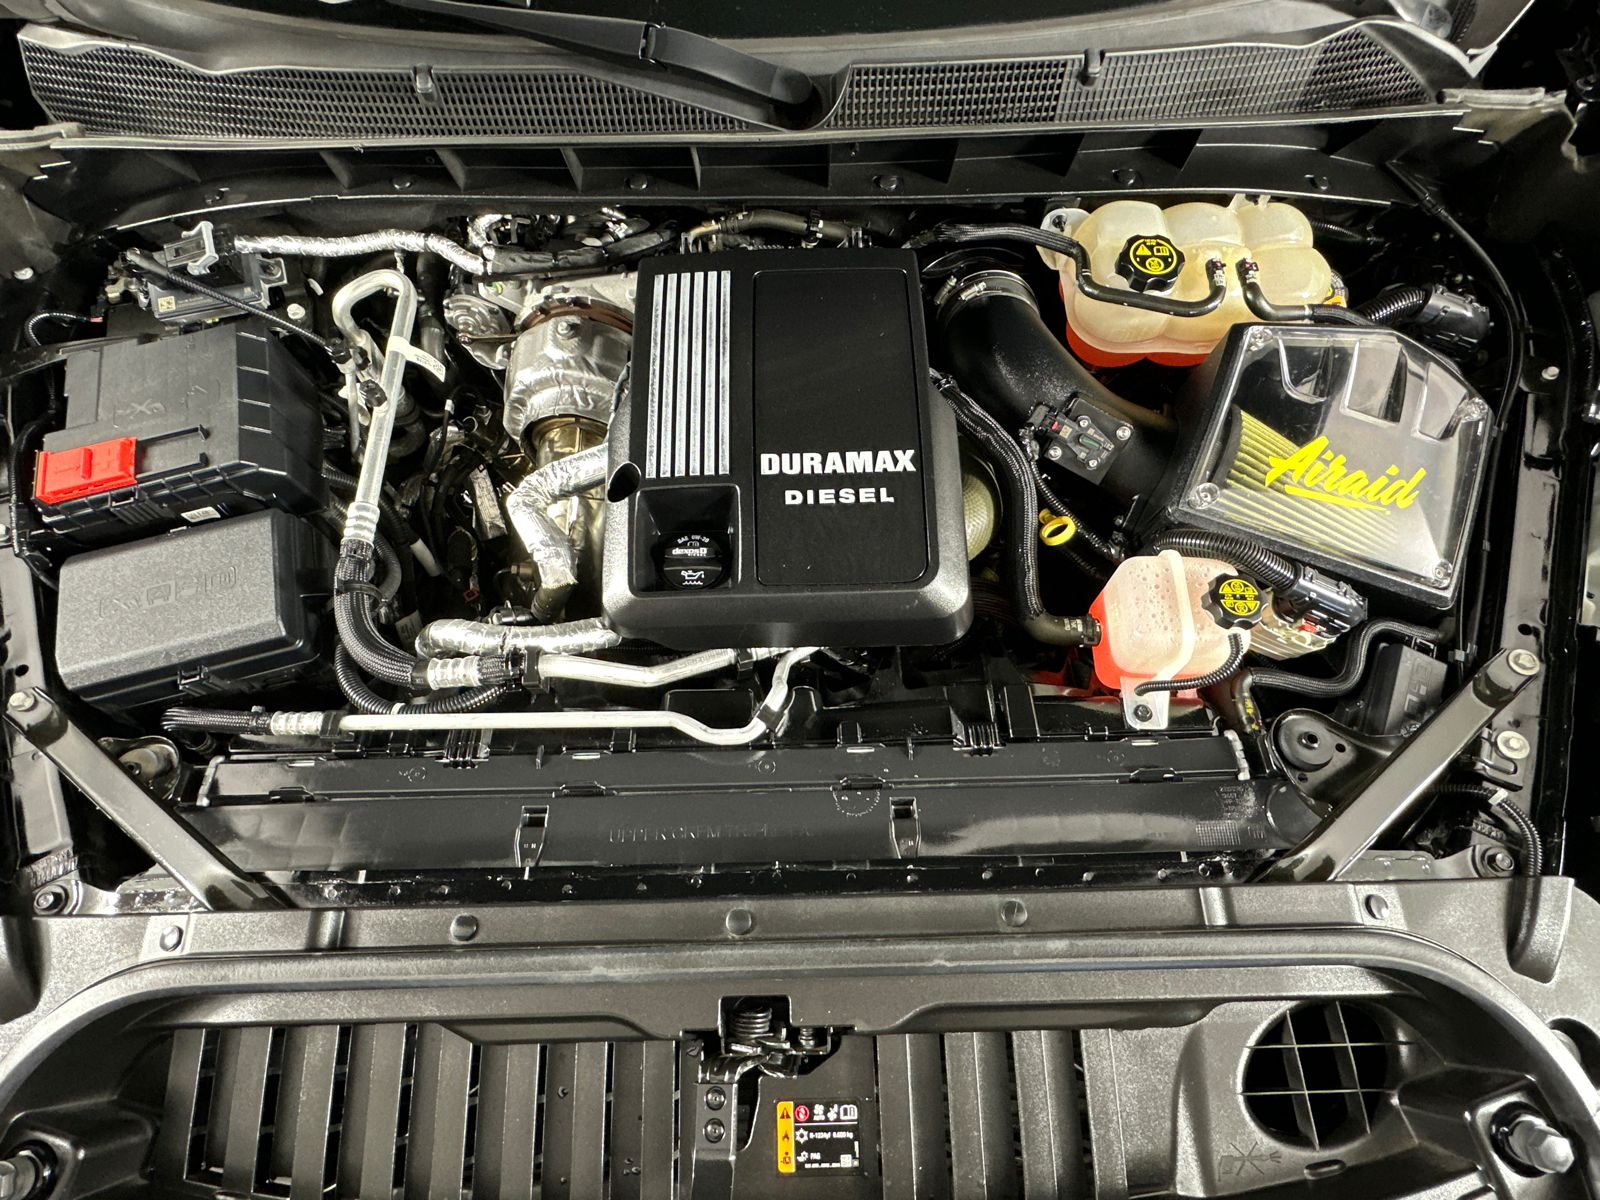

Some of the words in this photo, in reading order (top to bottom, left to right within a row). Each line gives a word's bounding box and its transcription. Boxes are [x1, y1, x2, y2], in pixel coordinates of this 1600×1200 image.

[760, 449, 917, 475] DURAMAX
[1265, 436, 1426, 509] Airaid
[784, 487, 895, 505] DIESEL
